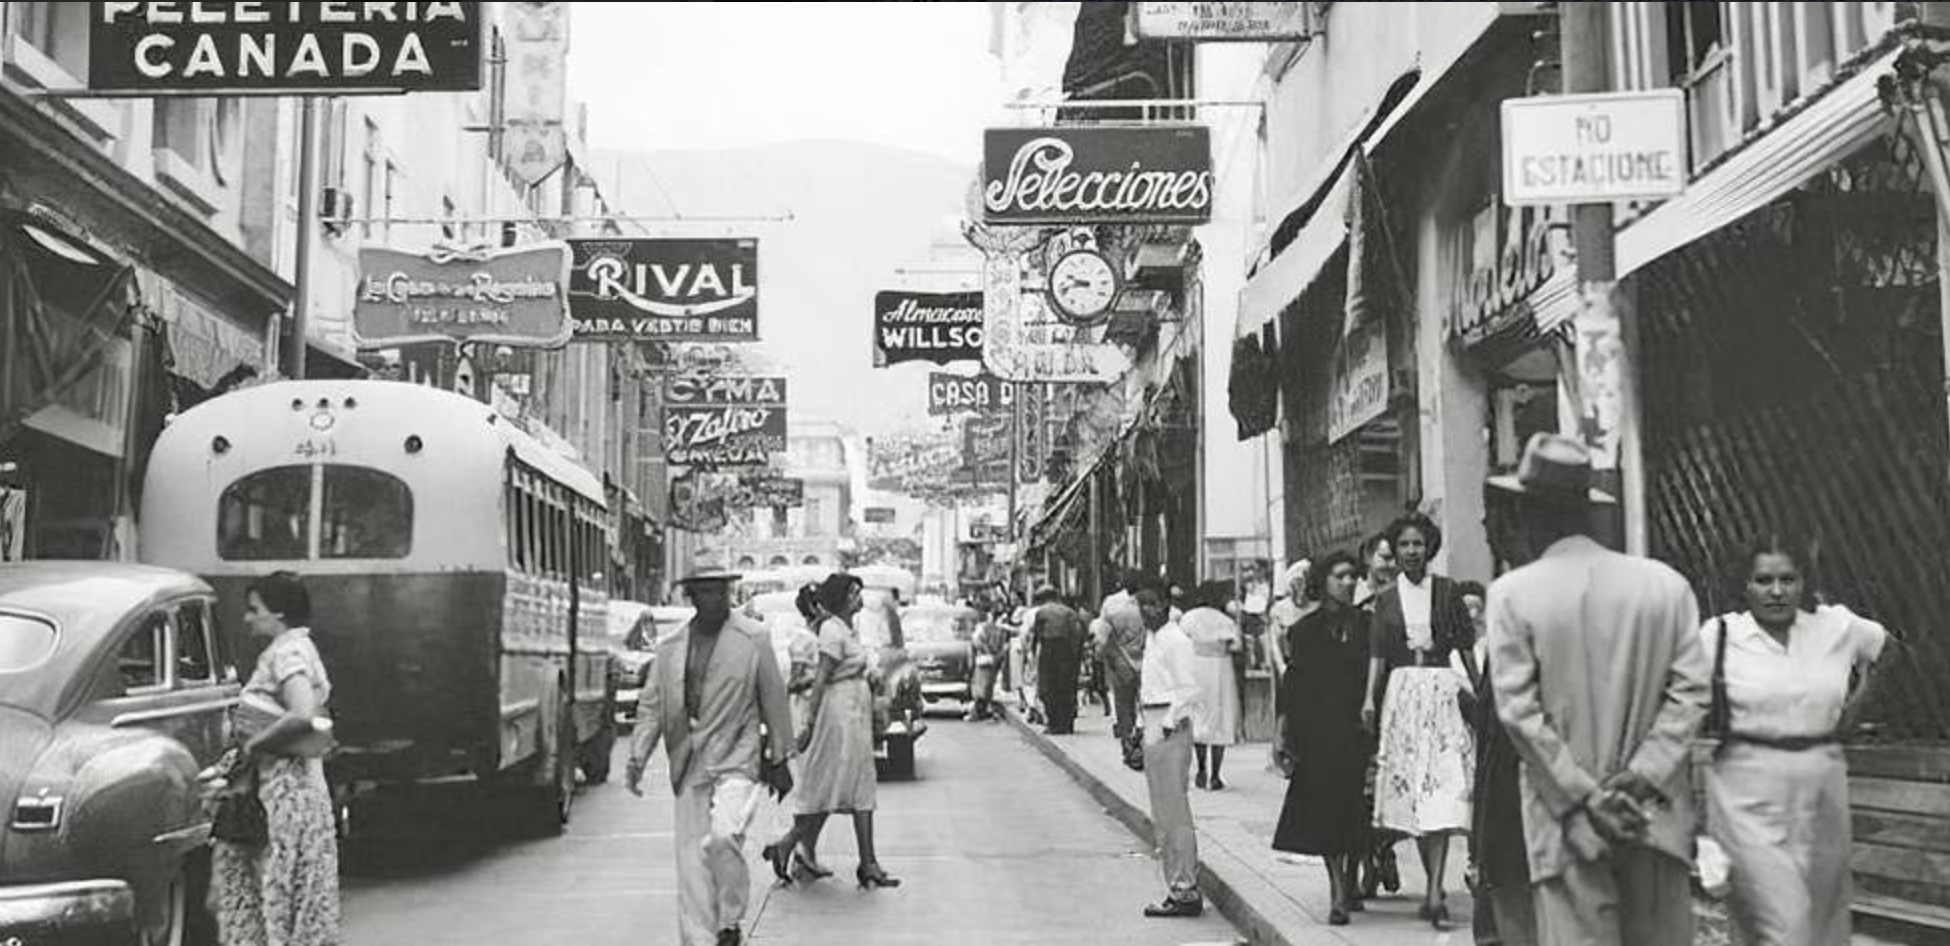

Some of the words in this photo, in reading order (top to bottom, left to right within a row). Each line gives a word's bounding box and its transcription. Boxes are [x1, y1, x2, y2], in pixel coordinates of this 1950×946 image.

[134, 32, 433, 78] CANADA
[1575, 113, 1612, 145] NO
[986, 136, 1210, 211] Selecciones
[1521, 151, 1672, 187] ESTACIONE
[587, 256, 756, 317] RIVAL
[668, 377, 780, 402] CYMA
[932, 380, 990, 405] CASA
